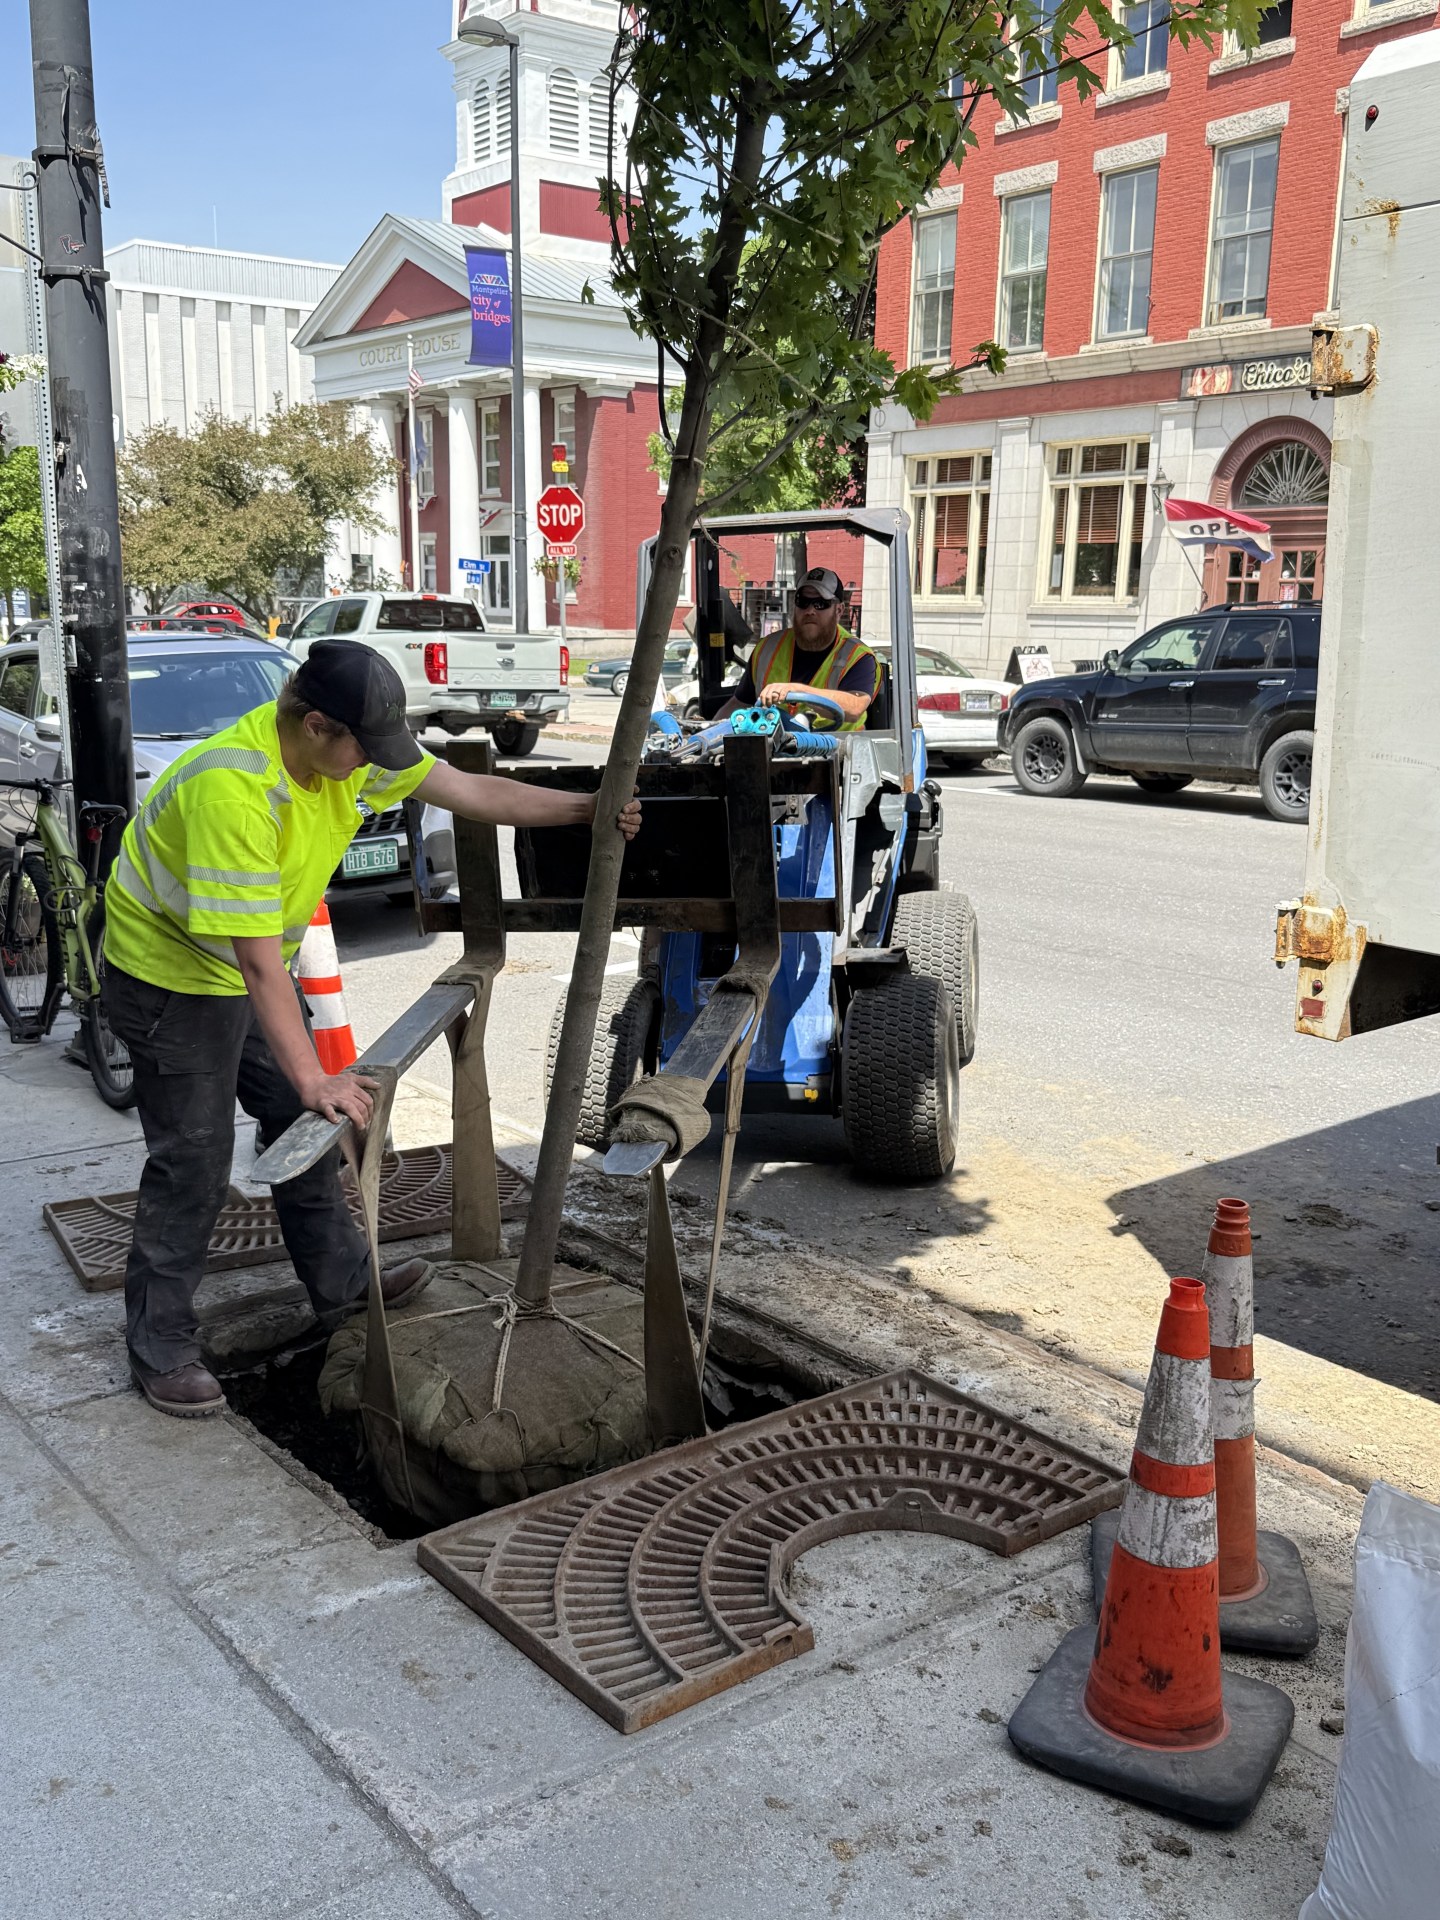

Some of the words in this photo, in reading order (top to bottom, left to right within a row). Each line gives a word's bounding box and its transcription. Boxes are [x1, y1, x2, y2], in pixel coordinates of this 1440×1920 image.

[472, 285, 508, 295] Montpelier
[472, 294, 491, 309] city
[493, 300, 501, 308] of
[473, 309, 510, 326] bridges
[360, 344, 404, 367] COURT
[412, 332, 460, 357] HOUSE
[1242, 357, 1311, 390] Chico's
[539, 504, 582, 527] STOP
[1189, 522, 1243, 536] OPE
[549, 546, 560, 554] ALL
[562, 546, 574, 555] WAY
[463, 560, 477, 569] Elm
[373, 849, 393, 865] 676
